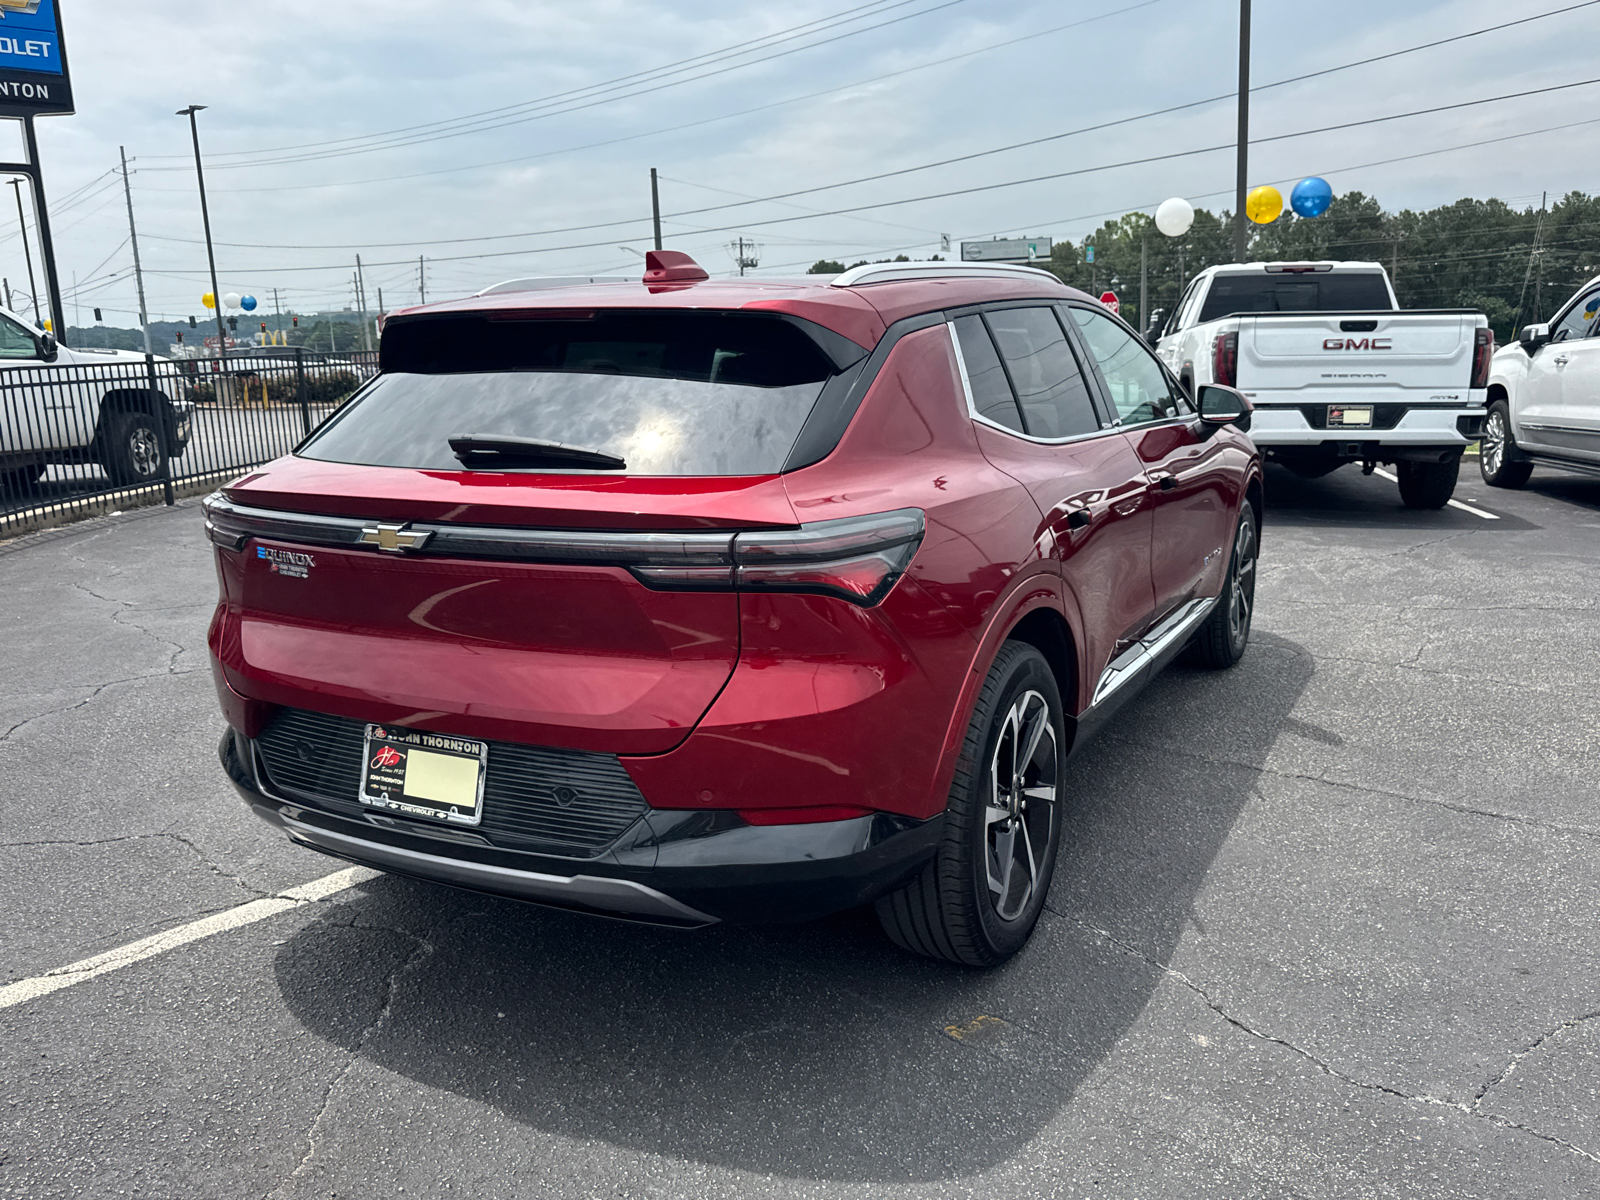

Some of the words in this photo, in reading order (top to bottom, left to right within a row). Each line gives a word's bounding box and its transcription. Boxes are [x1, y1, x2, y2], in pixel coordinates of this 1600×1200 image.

[1322, 338, 1392, 350] GMC
[256, 546, 316, 567] EQUINOX
[422, 736, 480, 754] THORNTON
[400, 803, 436, 817] CHEVROLET
